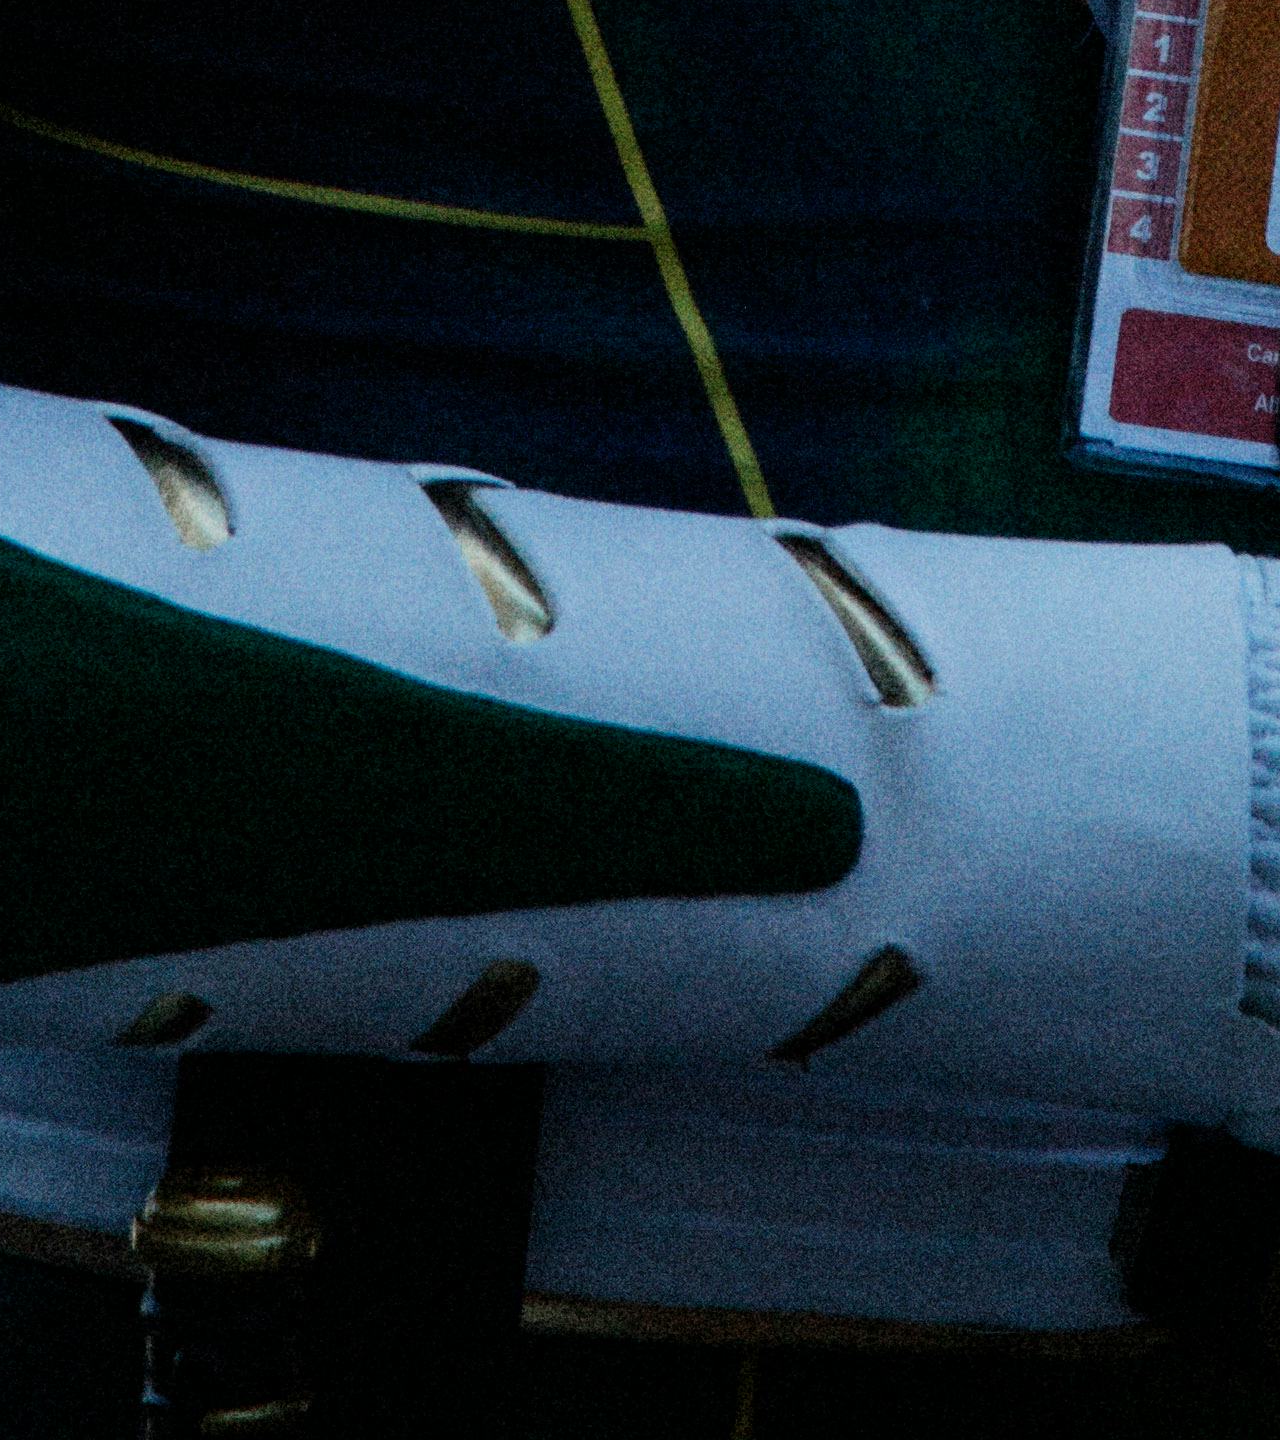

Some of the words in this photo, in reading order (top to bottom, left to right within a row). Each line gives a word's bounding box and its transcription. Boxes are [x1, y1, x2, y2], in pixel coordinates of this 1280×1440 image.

[1154, 35, 1172, 64] 1
[1143, 93, 1168, 123] 2
[1136, 150, 1161, 180] 3
[1129, 214, 1152, 245] 4
